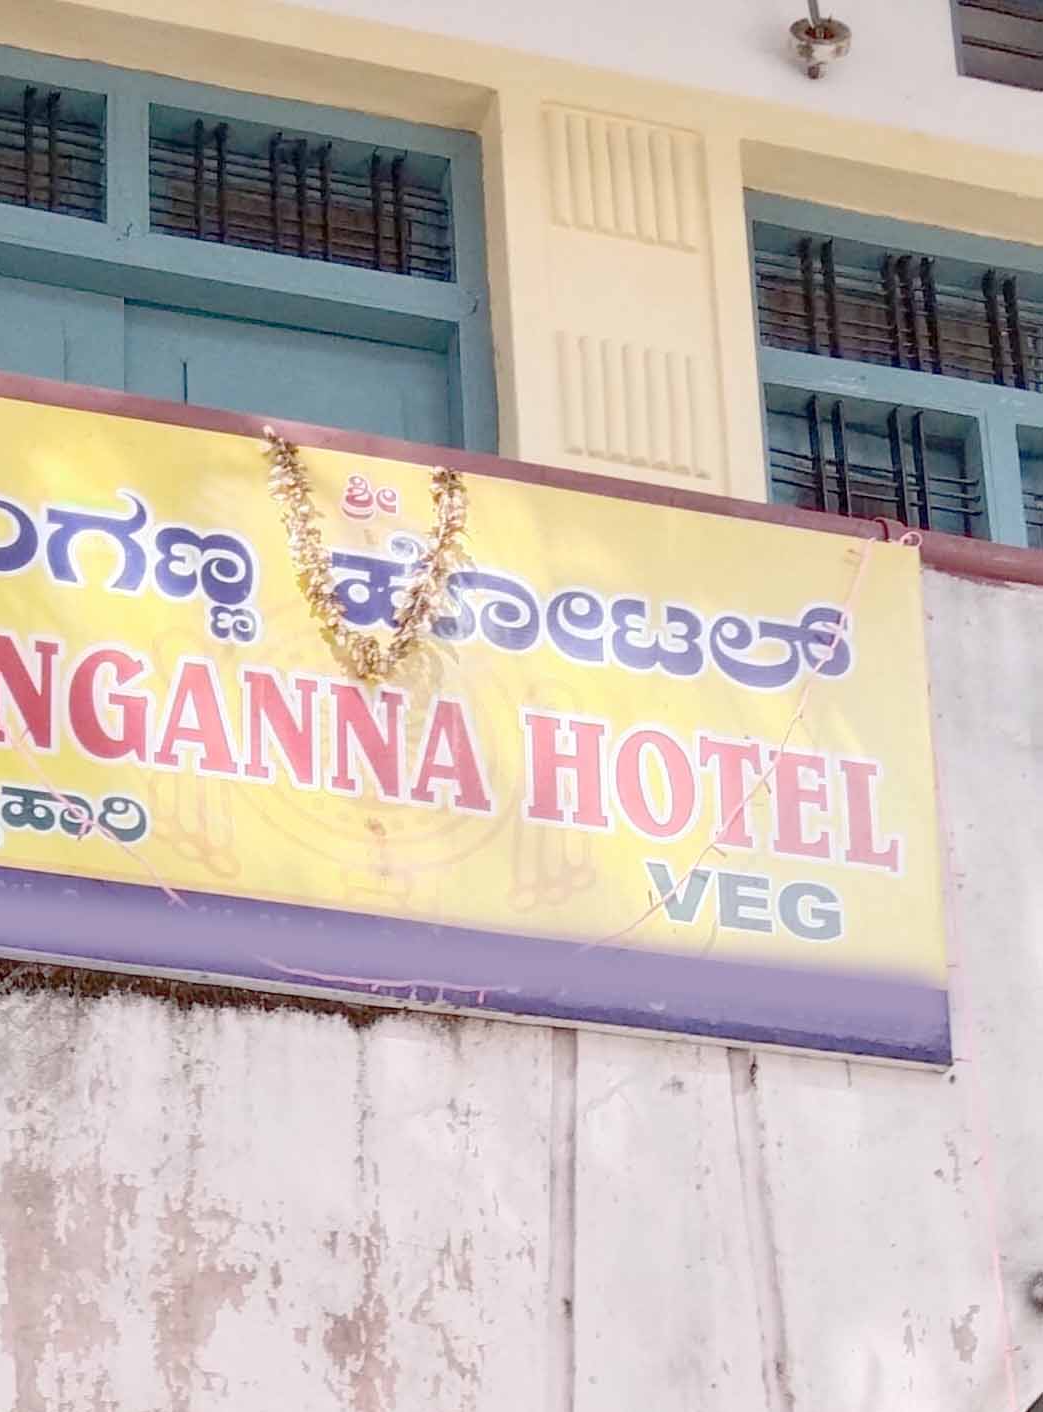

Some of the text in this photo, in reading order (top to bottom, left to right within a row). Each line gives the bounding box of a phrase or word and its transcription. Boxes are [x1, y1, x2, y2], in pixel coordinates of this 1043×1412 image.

[341, 474, 397, 519] ಶ್ರೀ
[525, 714, 899, 872] HOTEL
[646, 863, 843, 940] VEG
